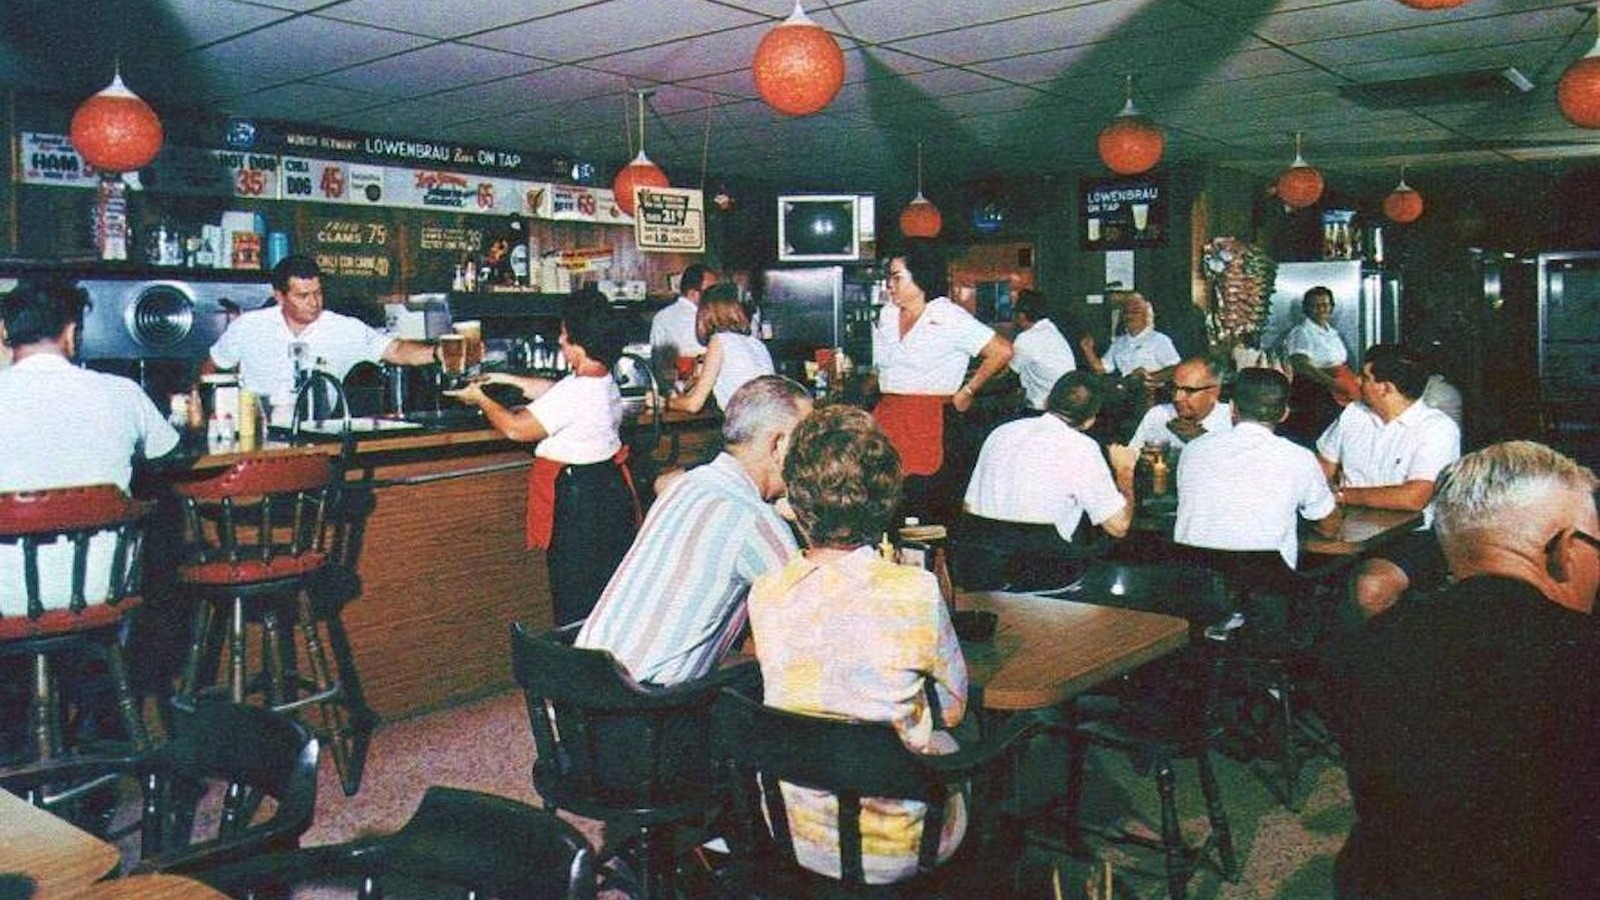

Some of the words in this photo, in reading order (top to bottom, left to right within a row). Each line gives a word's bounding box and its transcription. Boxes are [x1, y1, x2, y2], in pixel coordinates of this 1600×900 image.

[32, 153, 79, 172] HAM
[477, 150, 496, 165] ON
[498, 152, 521, 168] TAP
[287, 177, 312, 195] DOG
[1102, 203, 1120, 211] TAP
[318, 231, 361, 243] CLAMS
[368, 224, 385, 245] 75
